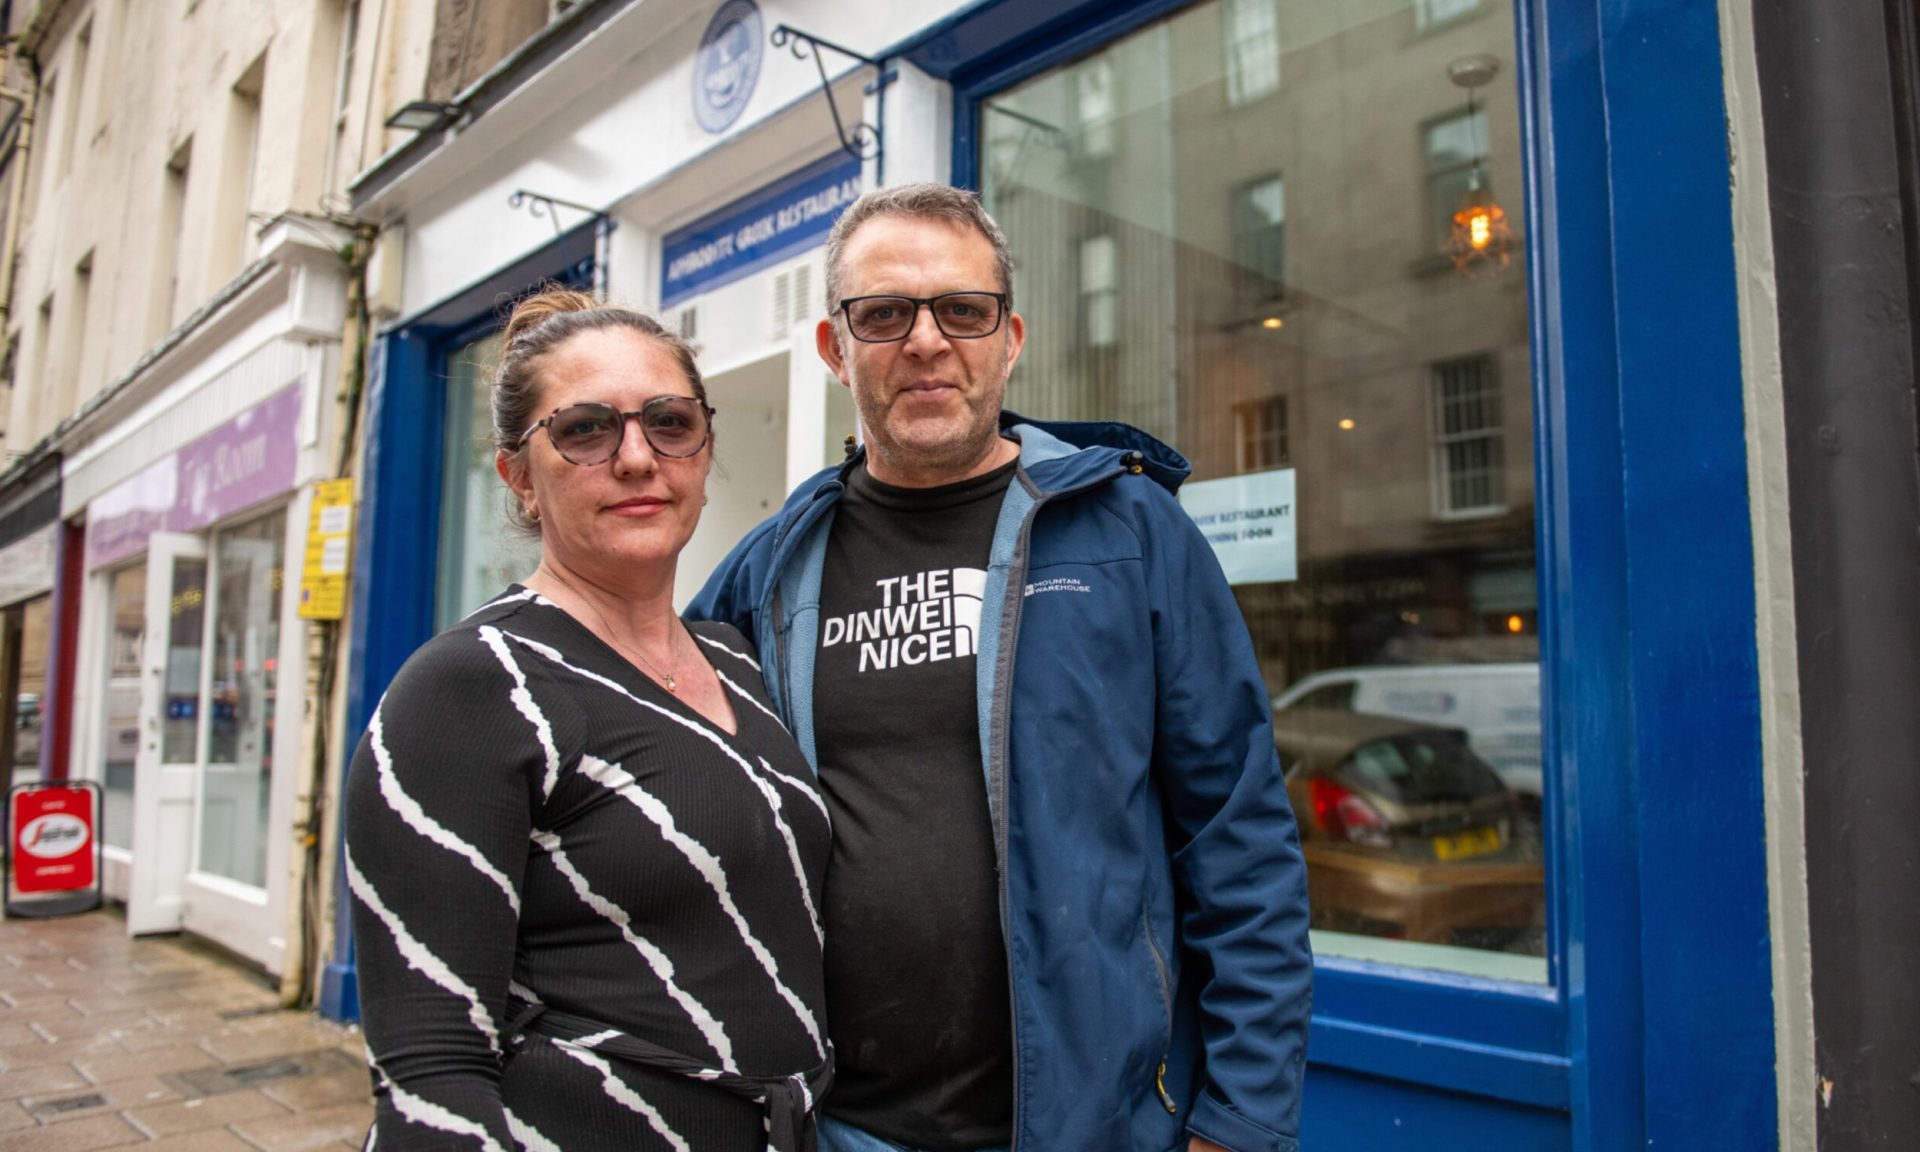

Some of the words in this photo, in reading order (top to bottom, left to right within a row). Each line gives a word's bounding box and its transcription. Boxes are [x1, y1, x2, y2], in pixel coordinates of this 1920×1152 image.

[1220, 504, 1290, 523] RESTAURANT
[876, 569, 950, 607] THE
[1034, 578, 1081, 588] MOUNTAIN
[1034, 585, 1092, 594] WAREHOUSE
[822, 597, 951, 648] DINWEI
[858, 629, 952, 673] NICE
